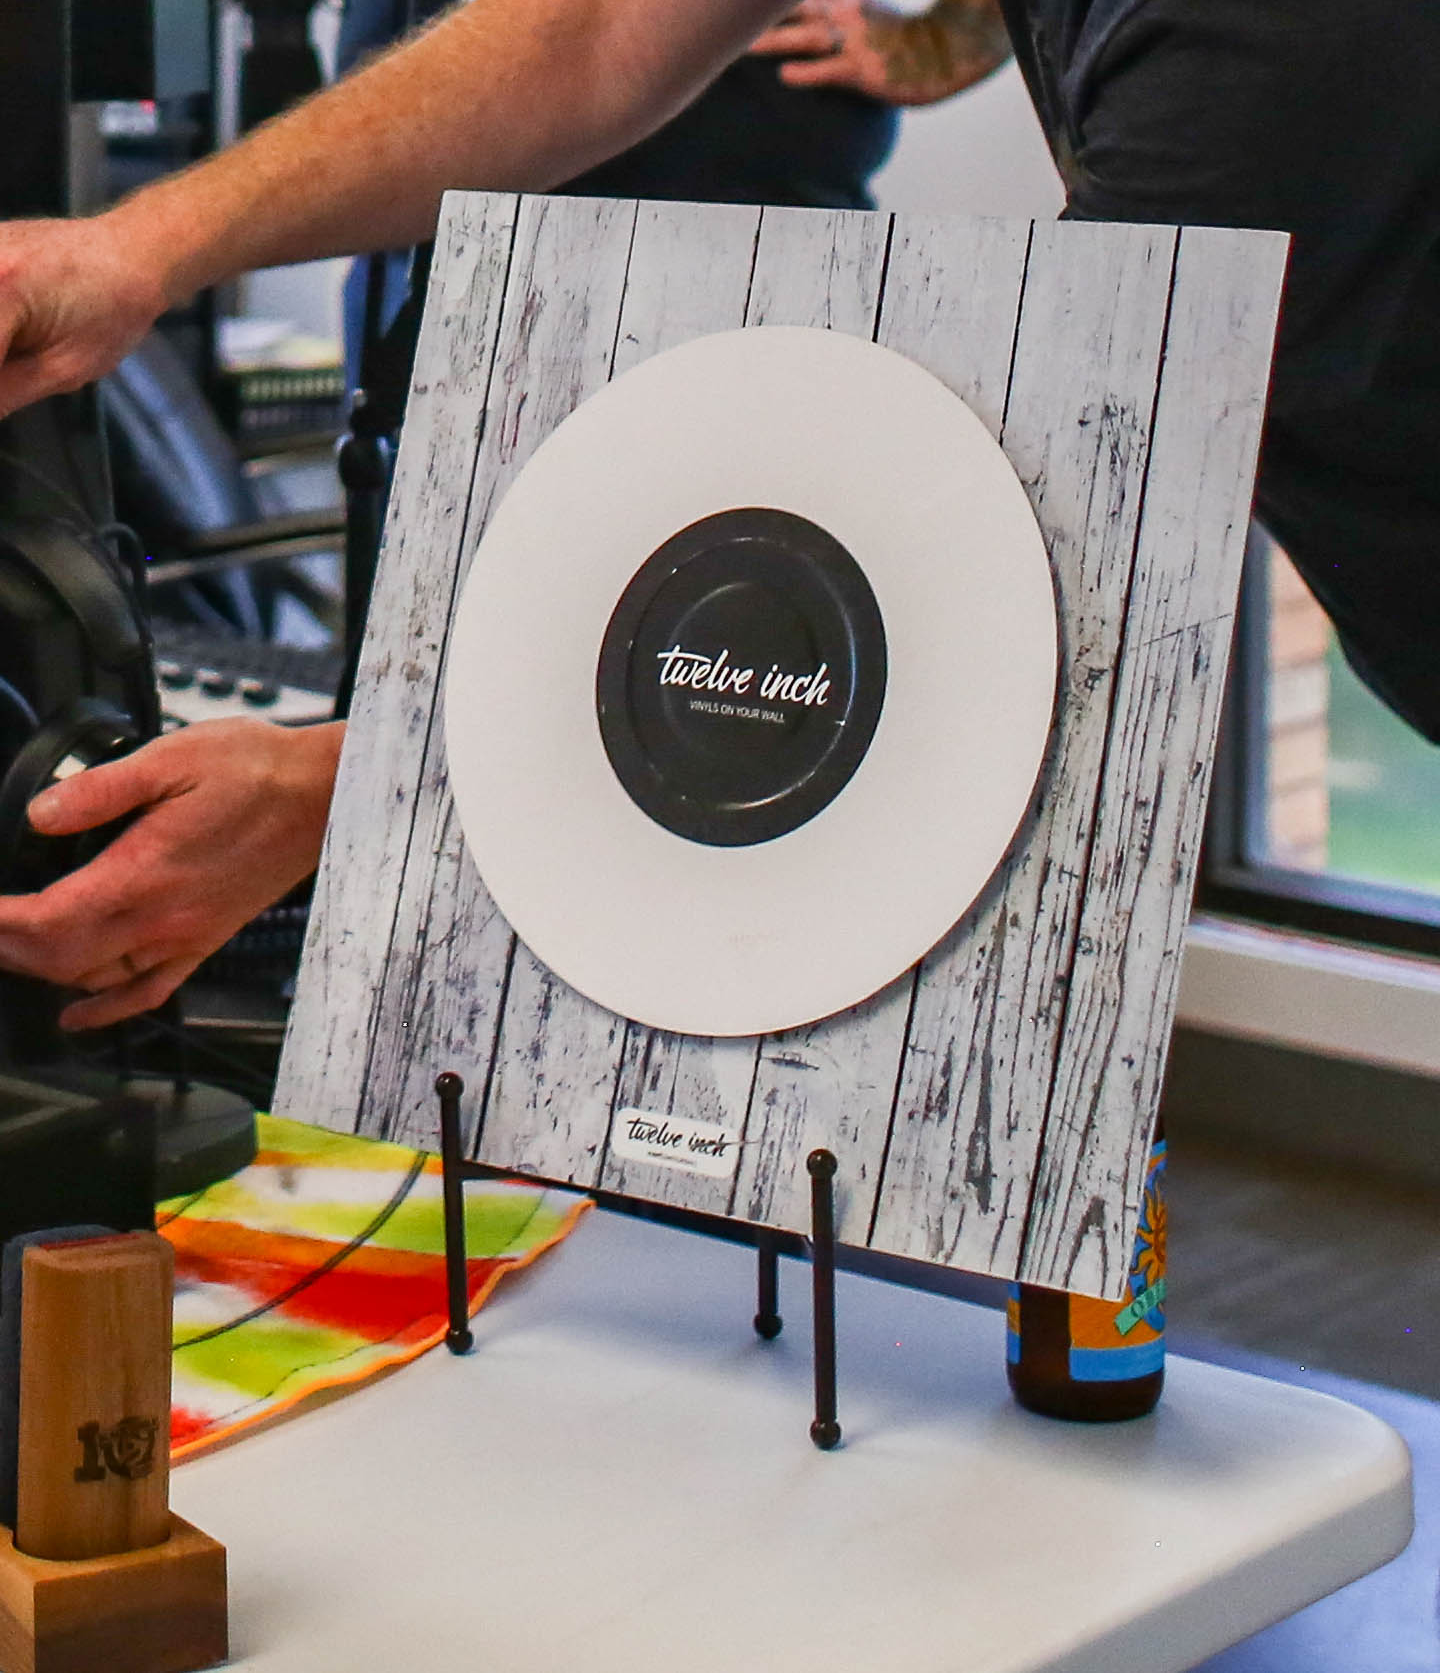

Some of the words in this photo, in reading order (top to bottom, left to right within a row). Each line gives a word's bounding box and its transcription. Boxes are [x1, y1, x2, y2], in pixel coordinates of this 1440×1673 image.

[657, 644, 754, 694] twelve
[759, 662, 831, 706] inch
[689, 699, 719, 714] VINYLS
[720, 704, 734, 715] ON
[735, 707, 760, 719] YOUR
[761, 709, 785, 724] WALL
[627, 1117, 683, 1148] twelve
[688, 1131, 728, 1158] inch
